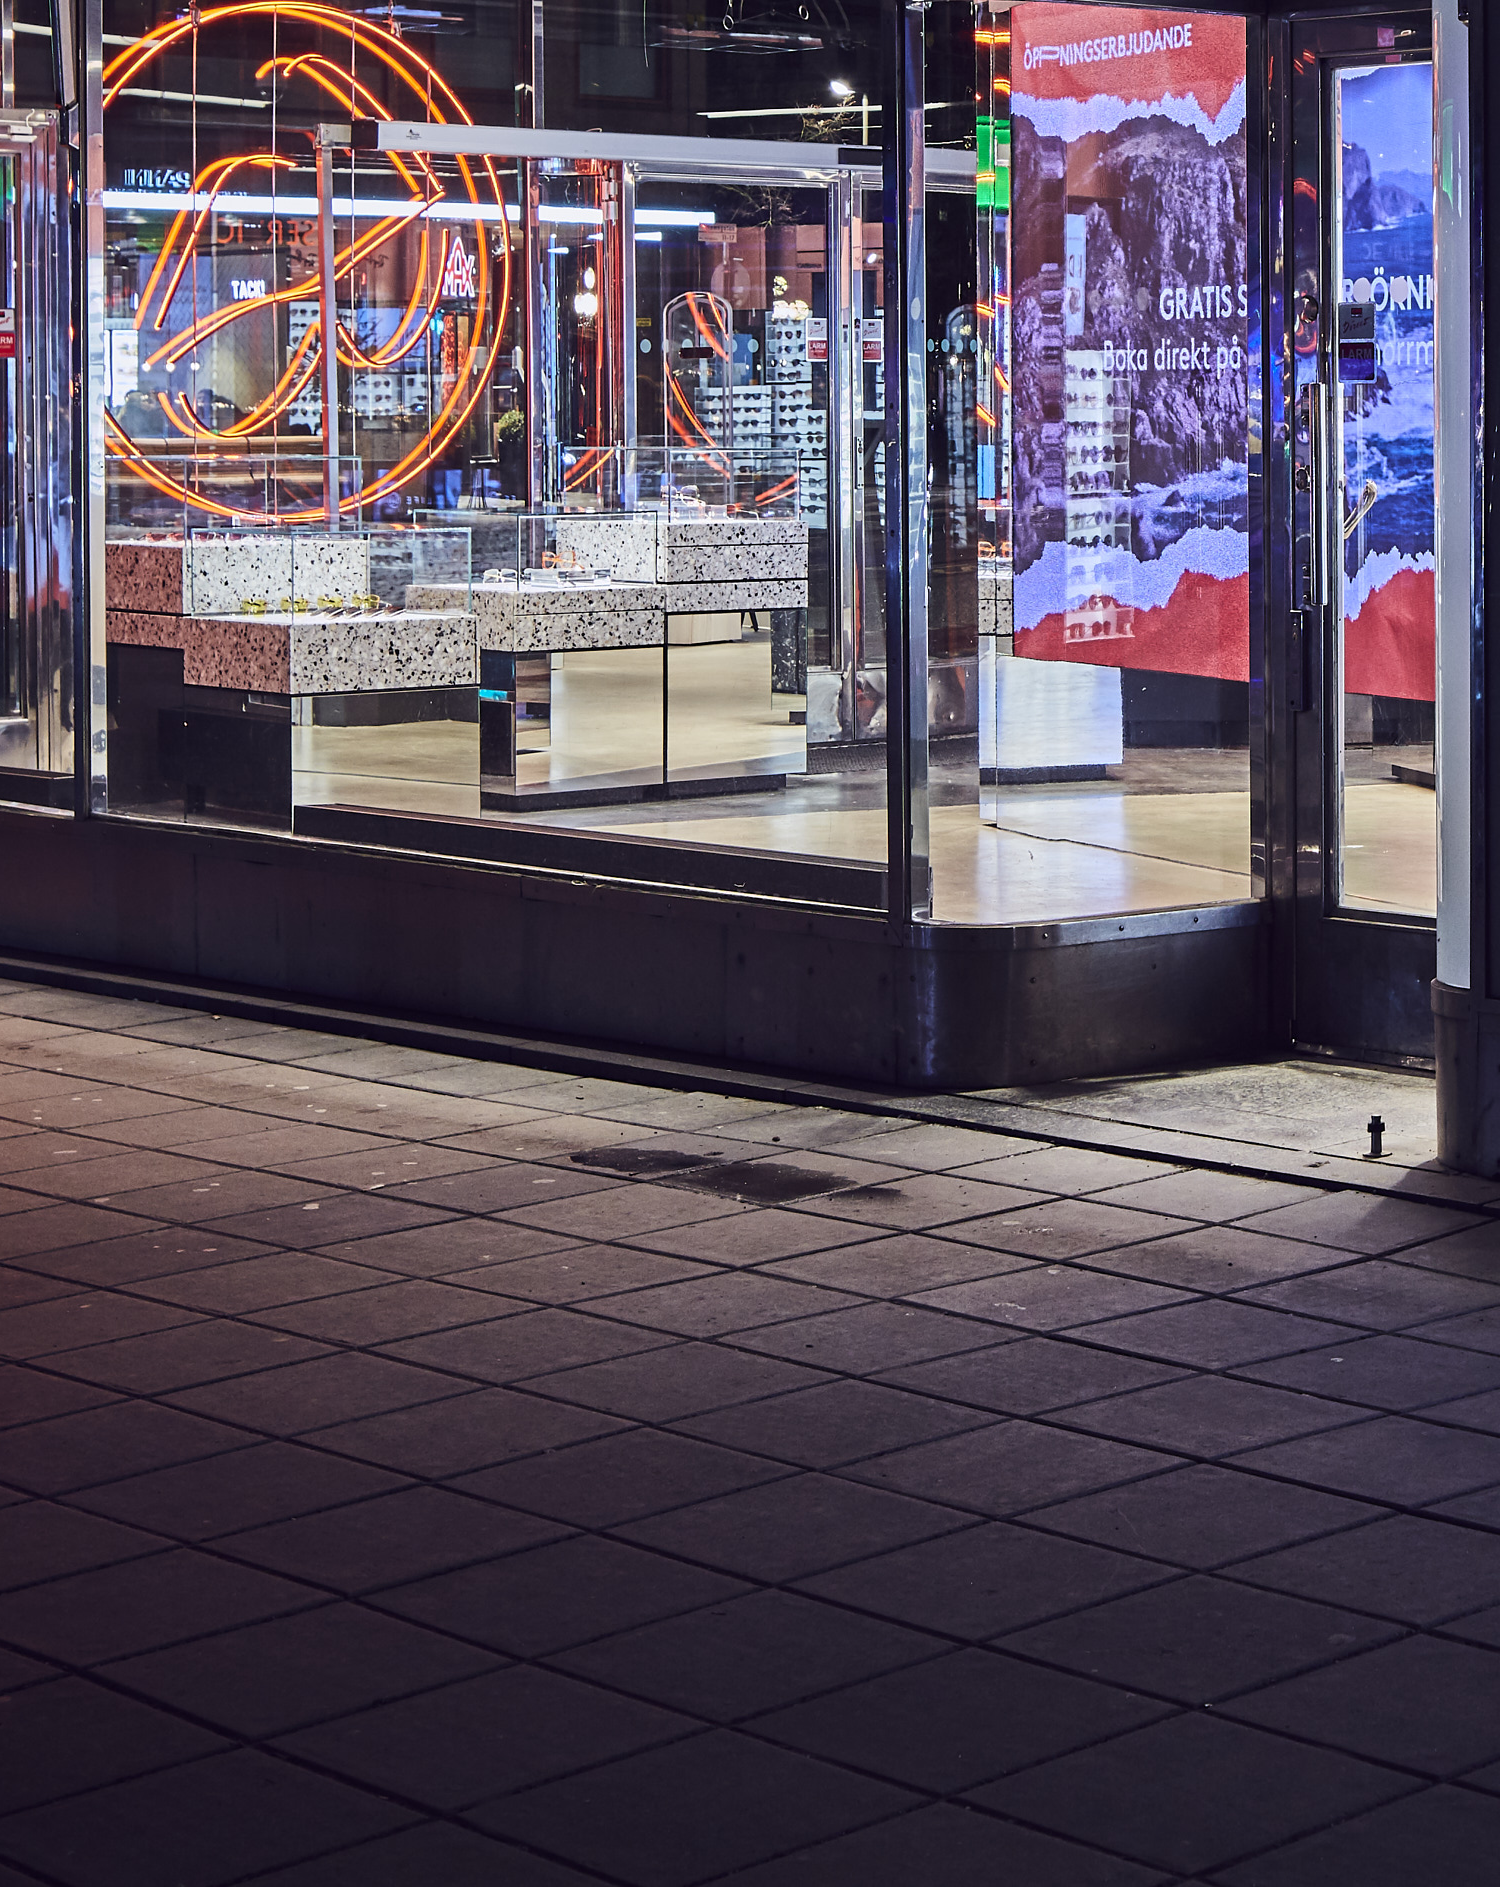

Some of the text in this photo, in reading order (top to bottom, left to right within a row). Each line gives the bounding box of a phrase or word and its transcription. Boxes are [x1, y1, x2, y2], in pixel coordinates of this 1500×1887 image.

[442, 236, 476, 299] MAX
[231, 280, 266, 300] TACK!
[1160, 285, 1233, 320] GRATIS
[809, 341, 827, 351] LARM
[863, 342, 881, 352] LARM
[1341, 348, 1373, 360] LARM
[1104, 335, 1241, 379] Boka direkt på
